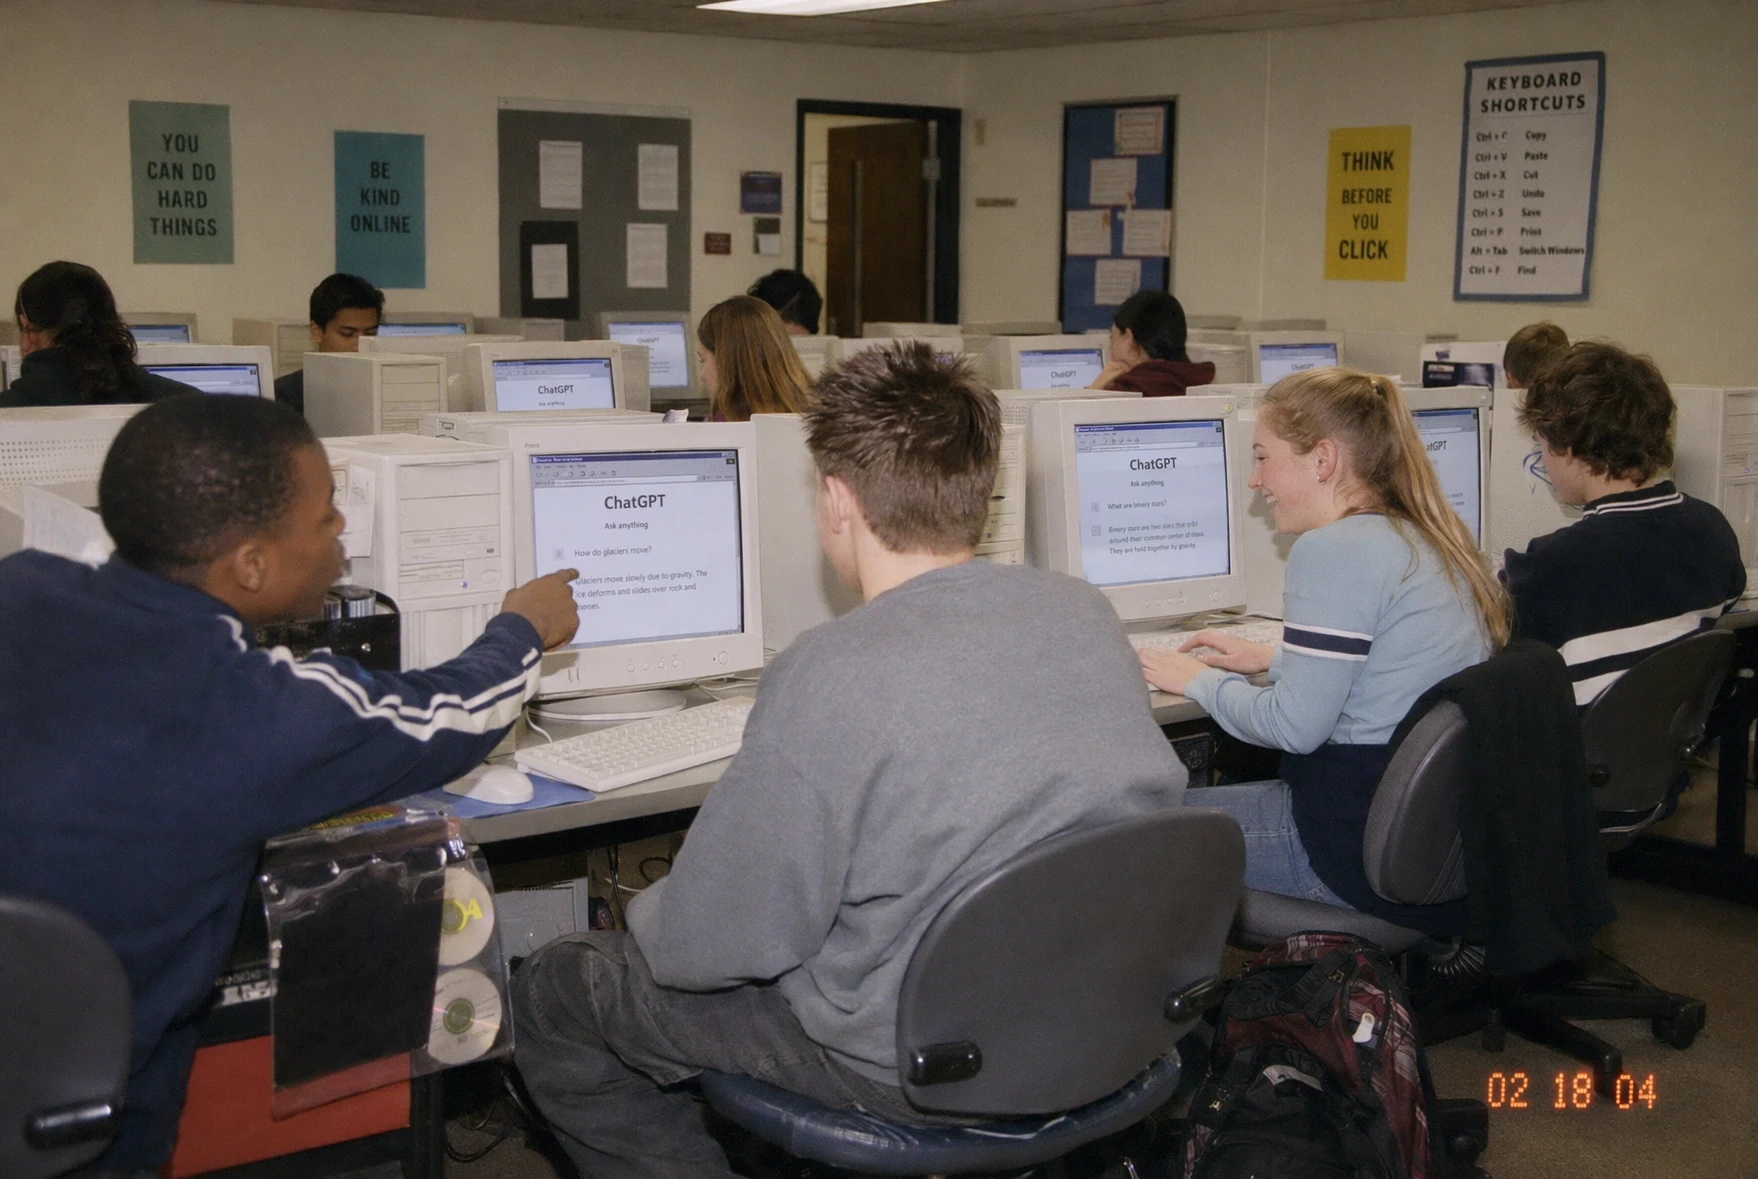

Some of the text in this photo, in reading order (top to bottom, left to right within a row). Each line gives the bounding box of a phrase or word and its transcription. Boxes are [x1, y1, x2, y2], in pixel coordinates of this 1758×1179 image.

[1486, 71, 1582, 91] KEYBOARD
[1480, 94, 1586, 113] SHORTCUTS
[162, 133, 198, 152] YOU
[1476, 132, 1492, 142] Ctrl
[1525, 130, 1547, 143] Copy
[1341, 150, 1394, 171] THINK
[1475, 153, 1491, 162] Ctrl
[1524, 151, 1548, 161] Paste
[147, 161, 216, 181] CAN DO
[370, 161, 391, 179] BE
[1474, 171, 1490, 181] Ctrl
[1523, 170, 1539, 180] Cut
[158, 190, 208, 208] HARD
[360, 188, 400, 206] KIND
[1341, 187, 1392, 205] BEFORE
[1473, 190, 1489, 199] Ctrl
[1522, 189, 1545, 198] Undo
[1472, 208, 1488, 218] Ctrl
[1521, 208, 1542, 217] Save
[150, 216, 218, 236] THINGS
[351, 215, 411, 233] ONLINE
[1352, 212, 1379, 230] YOU
[1471, 227, 1487, 237] Ctrl
[1520, 227, 1542, 236] Print
[1339, 239, 1389, 260] CLICK
[1470, 247, 1483, 256] Alt
[1493, 246, 1508, 255] Tab
[1519, 246, 1546, 256] Switch
[1547, 246, 1585, 255] Windows
[1469, 266, 1485, 275] Ctrl
[1517, 265, 1537, 275] Find
[537, 384, 574, 395] ChatGPT
[1129, 456, 1177, 471] ChatGPT
[1130, 479, 1164, 488] Ask anything
[604, 494, 666, 510] ChatGPT
[1133, 501, 1150, 509] binary
[1151, 499, 1167, 507] stars?
[604, 521, 649, 531] Ask anything
[1108, 525, 1126, 533] Binary
[1127, 524, 1140, 532] stars
[1109, 536, 1129, 544] around
[1143, 534, 1167, 542] common
[574, 546, 653, 558] How do glaciers move?
[1109, 547, 1123, 555] They
[604, 575, 624, 584] move
[625, 573, 646, 583] slowly
[647, 572, 660, 580] due
[661, 571, 669, 579] to
[670, 571, 694, 581] gravity.
[696, 569, 708, 577] The
[587, 588, 616, 598] deforms
[617, 587, 630, 596] and
[631, 586, 651, 595] slides
[652, 586, 667, 594] over
[668, 584, 682, 592] rock
[684, 583, 697, 591] and
